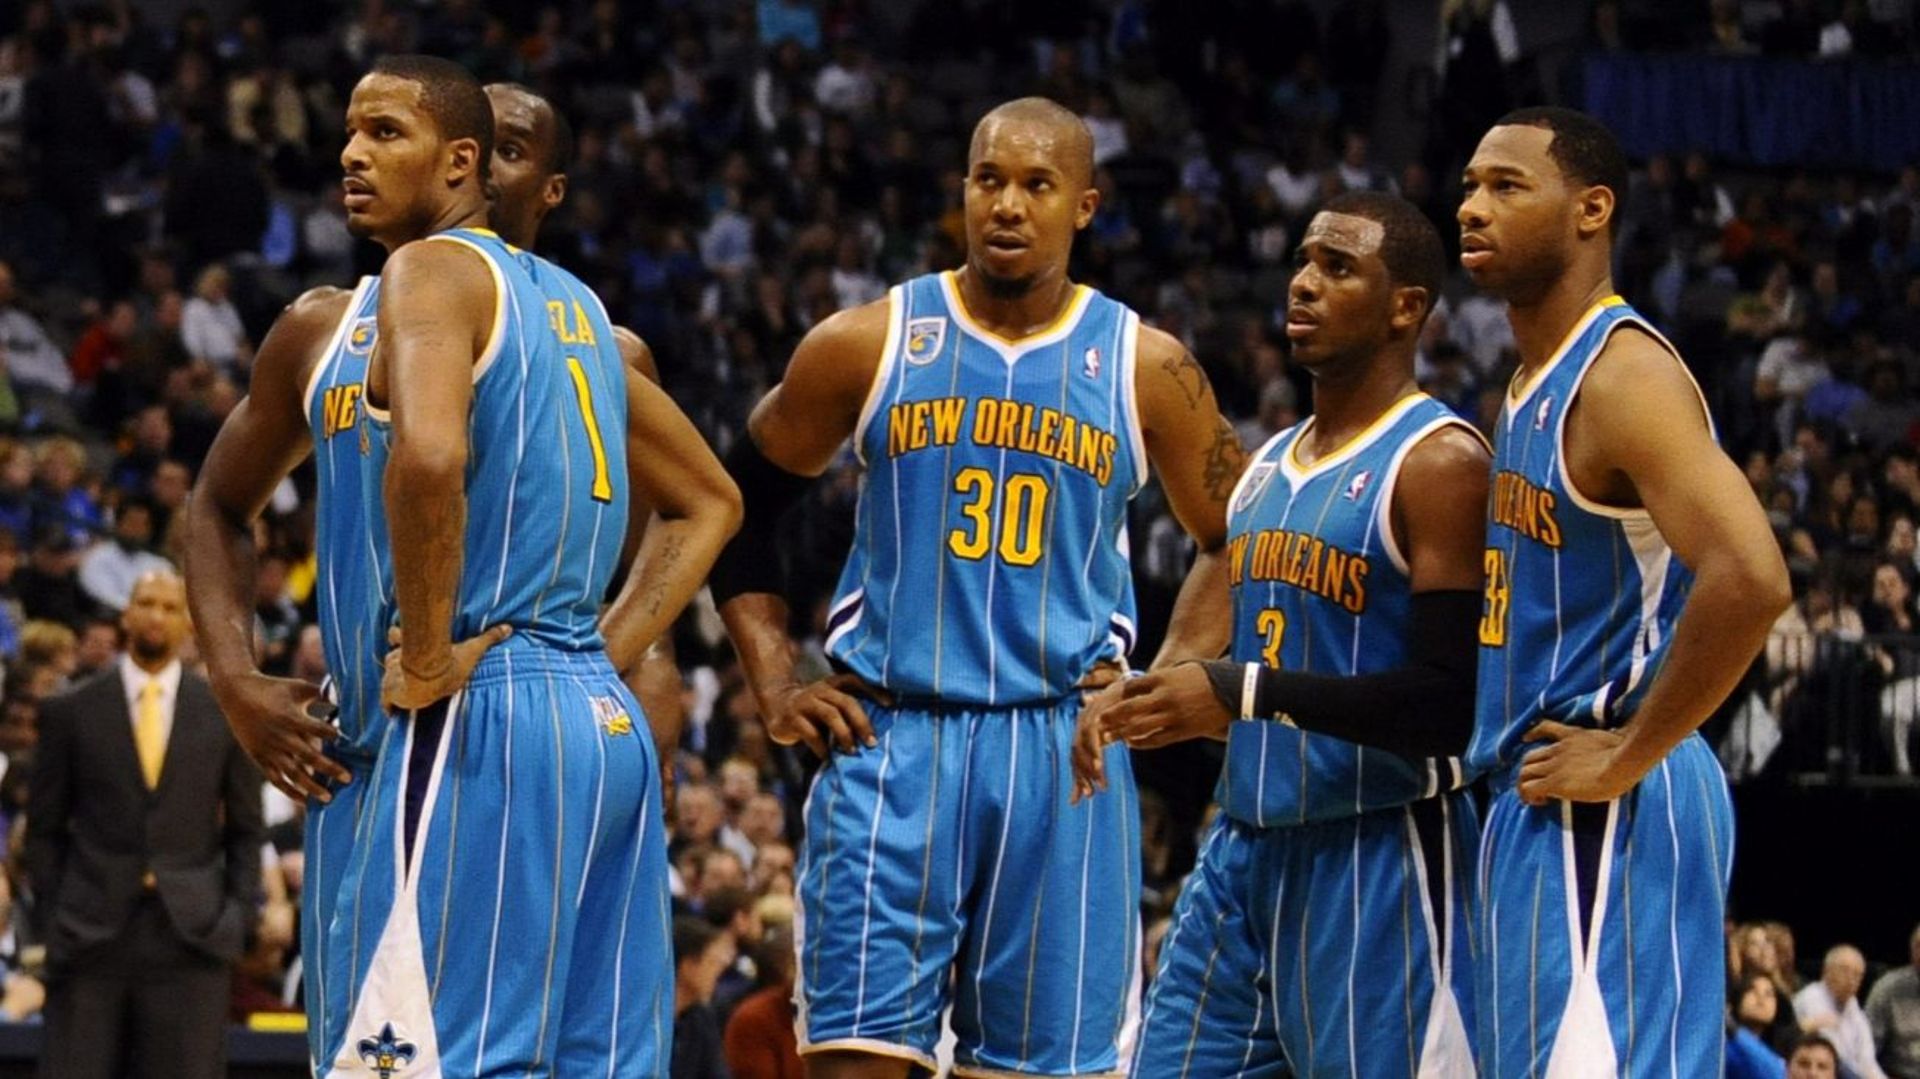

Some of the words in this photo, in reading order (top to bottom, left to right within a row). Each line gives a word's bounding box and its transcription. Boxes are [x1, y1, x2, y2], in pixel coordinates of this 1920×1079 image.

[323, 384, 363, 441] NE
[564, 355, 613, 504] 1
[889, 398, 966, 459] NEW
[972, 397, 1119, 488] ORLEANS
[948, 466, 1049, 567] 30
[1251, 529, 1369, 615] ORLEANS
[1256, 607, 1287, 670] 3
